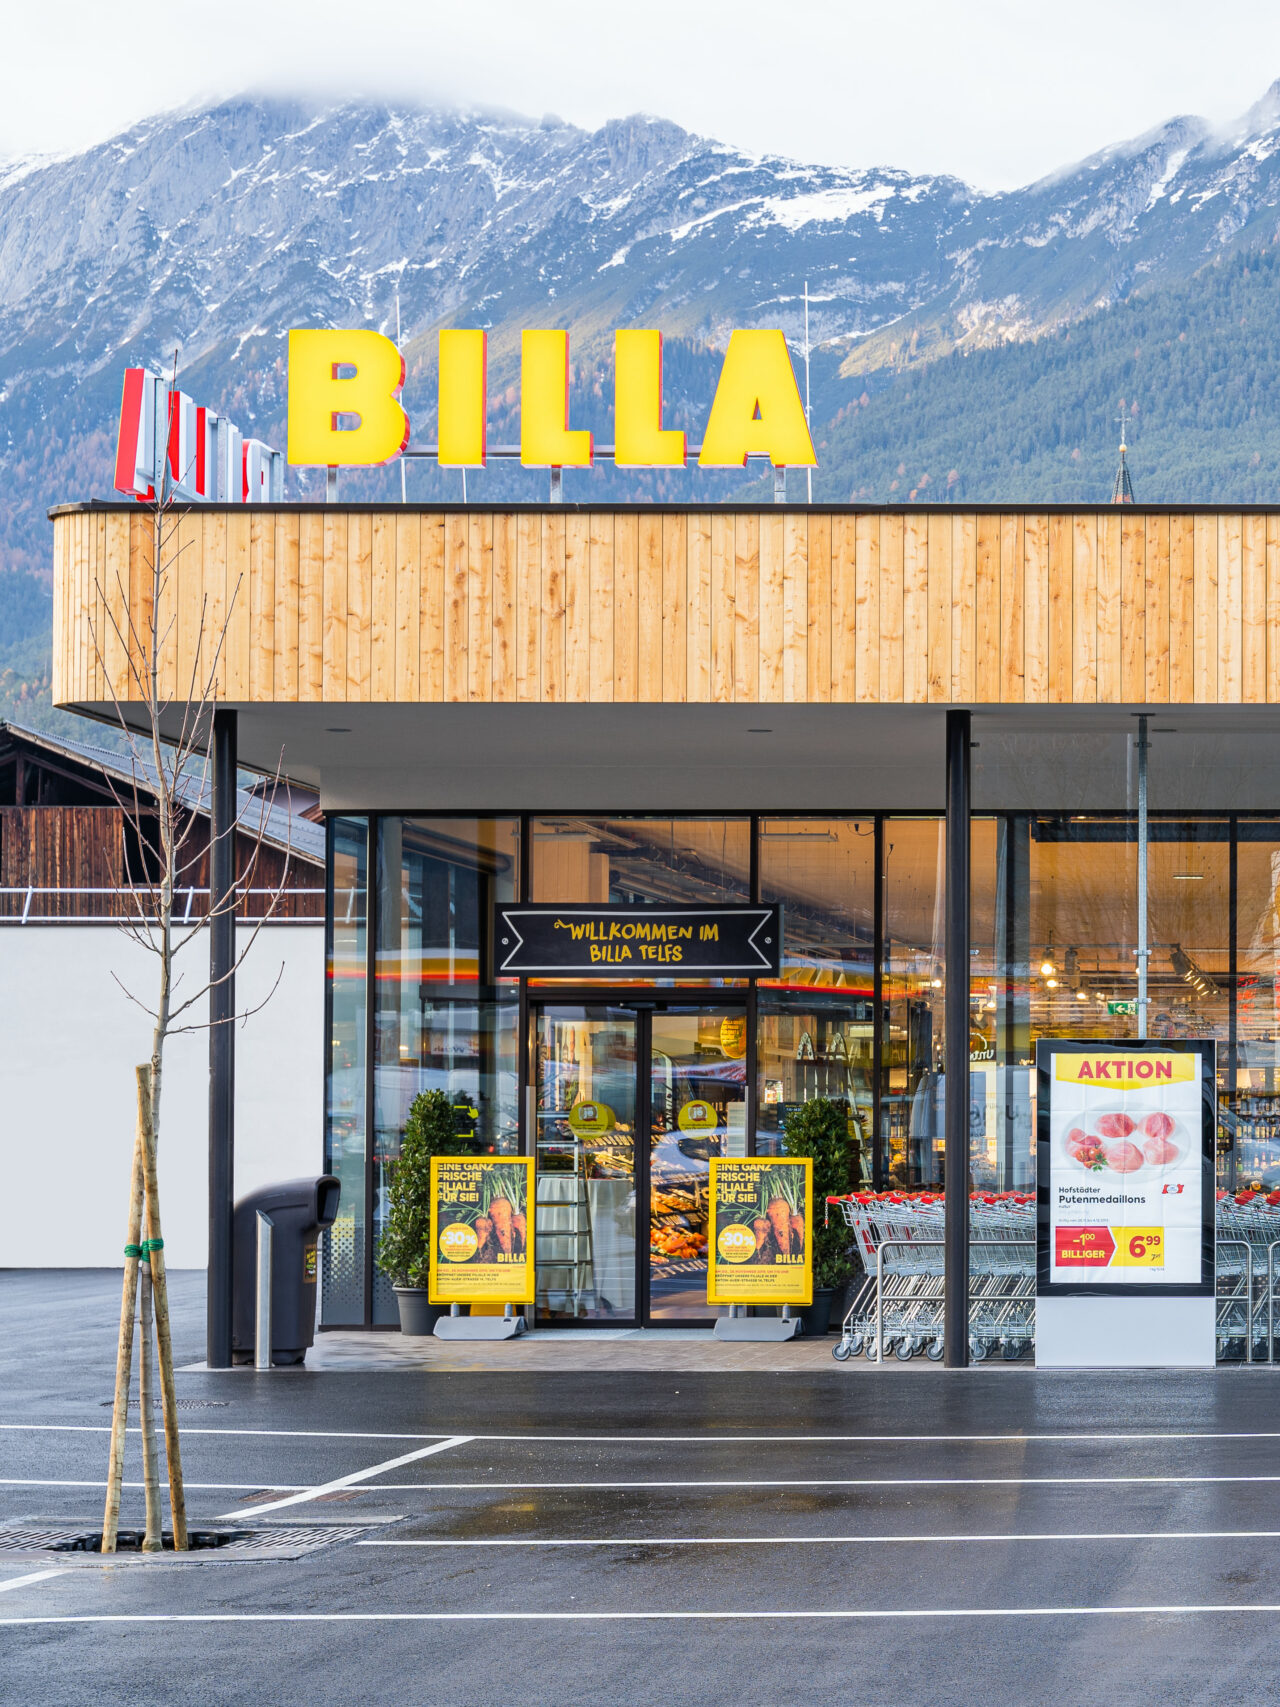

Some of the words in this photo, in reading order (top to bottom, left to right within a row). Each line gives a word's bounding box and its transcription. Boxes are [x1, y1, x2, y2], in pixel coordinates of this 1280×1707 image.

[287, 329, 818, 468] BILLA
[554, 919, 692, 941] WILLKOMMEN
[700, 924, 719, 941] IM
[590, 945, 632, 962] BILLA
[639, 945, 683, 962] TELFS
[1078, 1061, 1173, 1079] AKTION
[438, 1163, 461, 1171] EINE
[464, 1163, 494, 1171] GANZ
[438, 1172, 482, 1181] FRISCHE
[716, 1172, 760, 1182] FRISCHE
[438, 1182, 476, 1191] FILIALE
[716, 1183, 754, 1192] FILIALE
[438, 1191, 459, 1202] FÜR
[460, 1193, 479, 1202] SIE!
[716, 1192, 737, 1203] FÜR
[738, 1193, 757, 1203] SIE!
[1058, 1195, 1146, 1204] Putenmedaillons
[441, 1232, 476, 1245] -30%
[720, 1232, 754, 1246] -30%
[497, 1253, 525, 1262] BILLA
[776, 1254, 804, 1263] BILLA
[1061, 1250, 1105, 1259] BILLIGER
